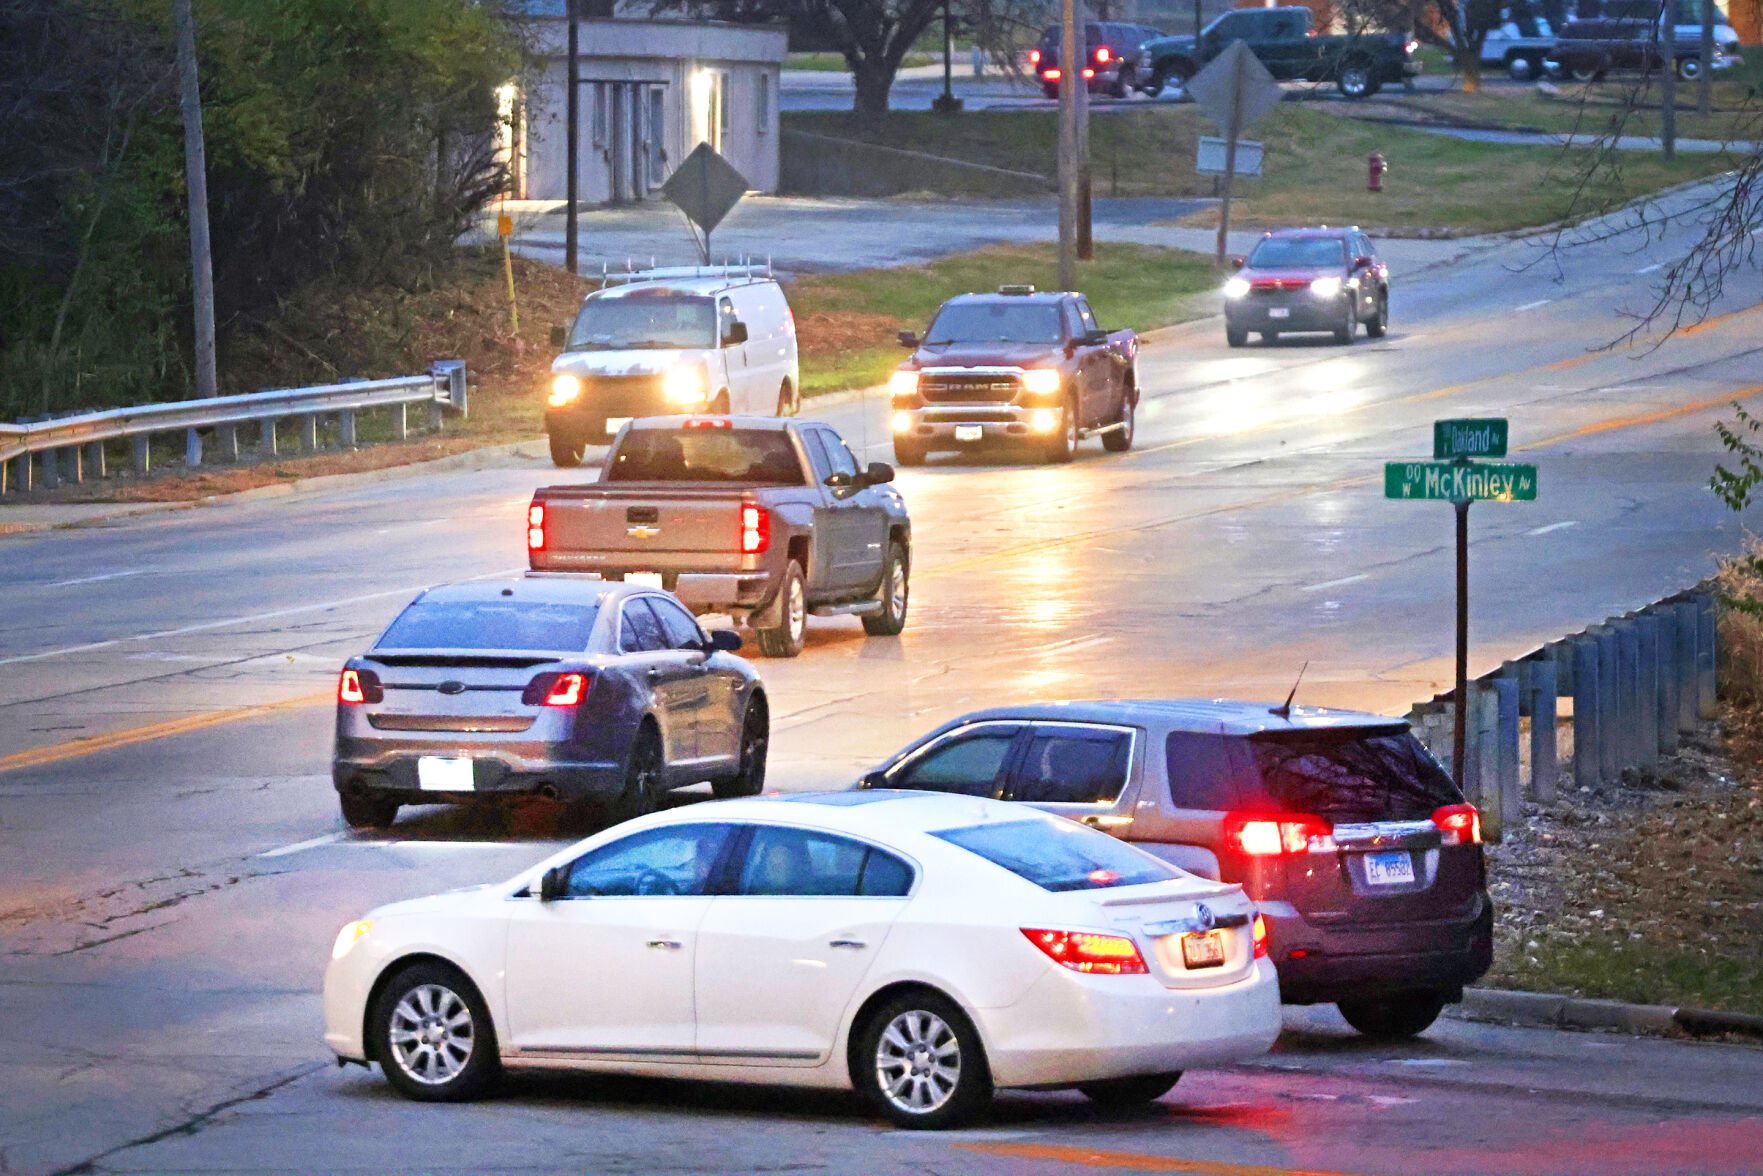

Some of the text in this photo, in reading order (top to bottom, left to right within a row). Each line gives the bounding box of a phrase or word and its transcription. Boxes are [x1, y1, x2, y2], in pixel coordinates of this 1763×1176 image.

[949, 383, 989, 391] RAM
[1402, 466, 1531, 500] W McKinley Av
